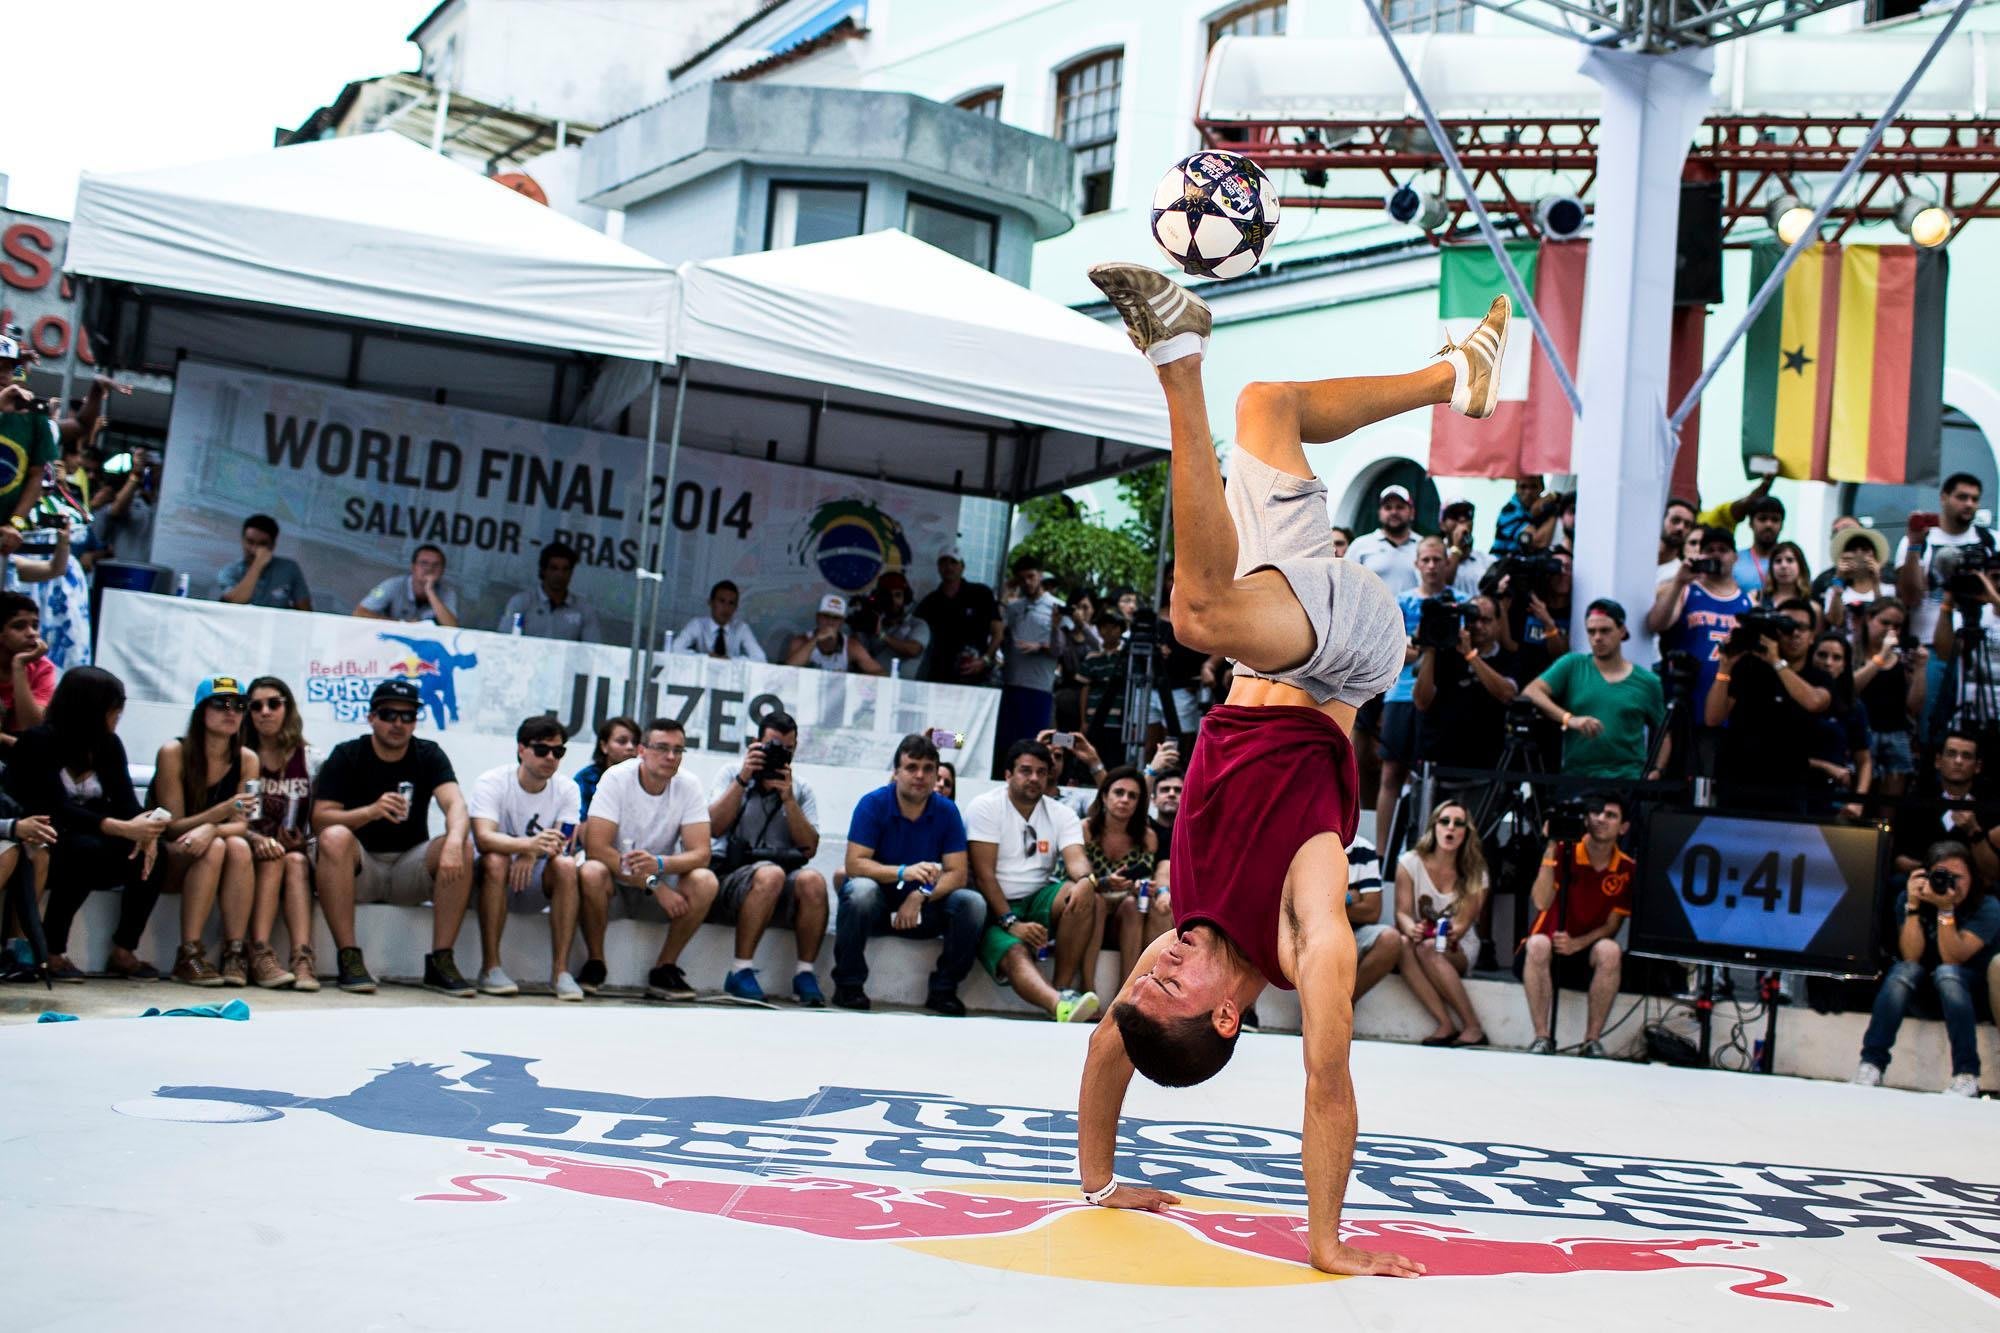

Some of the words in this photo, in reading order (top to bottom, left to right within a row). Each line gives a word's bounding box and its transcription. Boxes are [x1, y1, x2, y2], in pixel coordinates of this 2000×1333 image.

[264, 411, 463, 493] WORLD
[476, 449, 624, 521] FINAL
[638, 474, 754, 540] 2014
[342, 497, 522, 556] SALVADOR
[553, 528, 666, 577] RASL
[1681, 843, 1807, 915] 0:41
